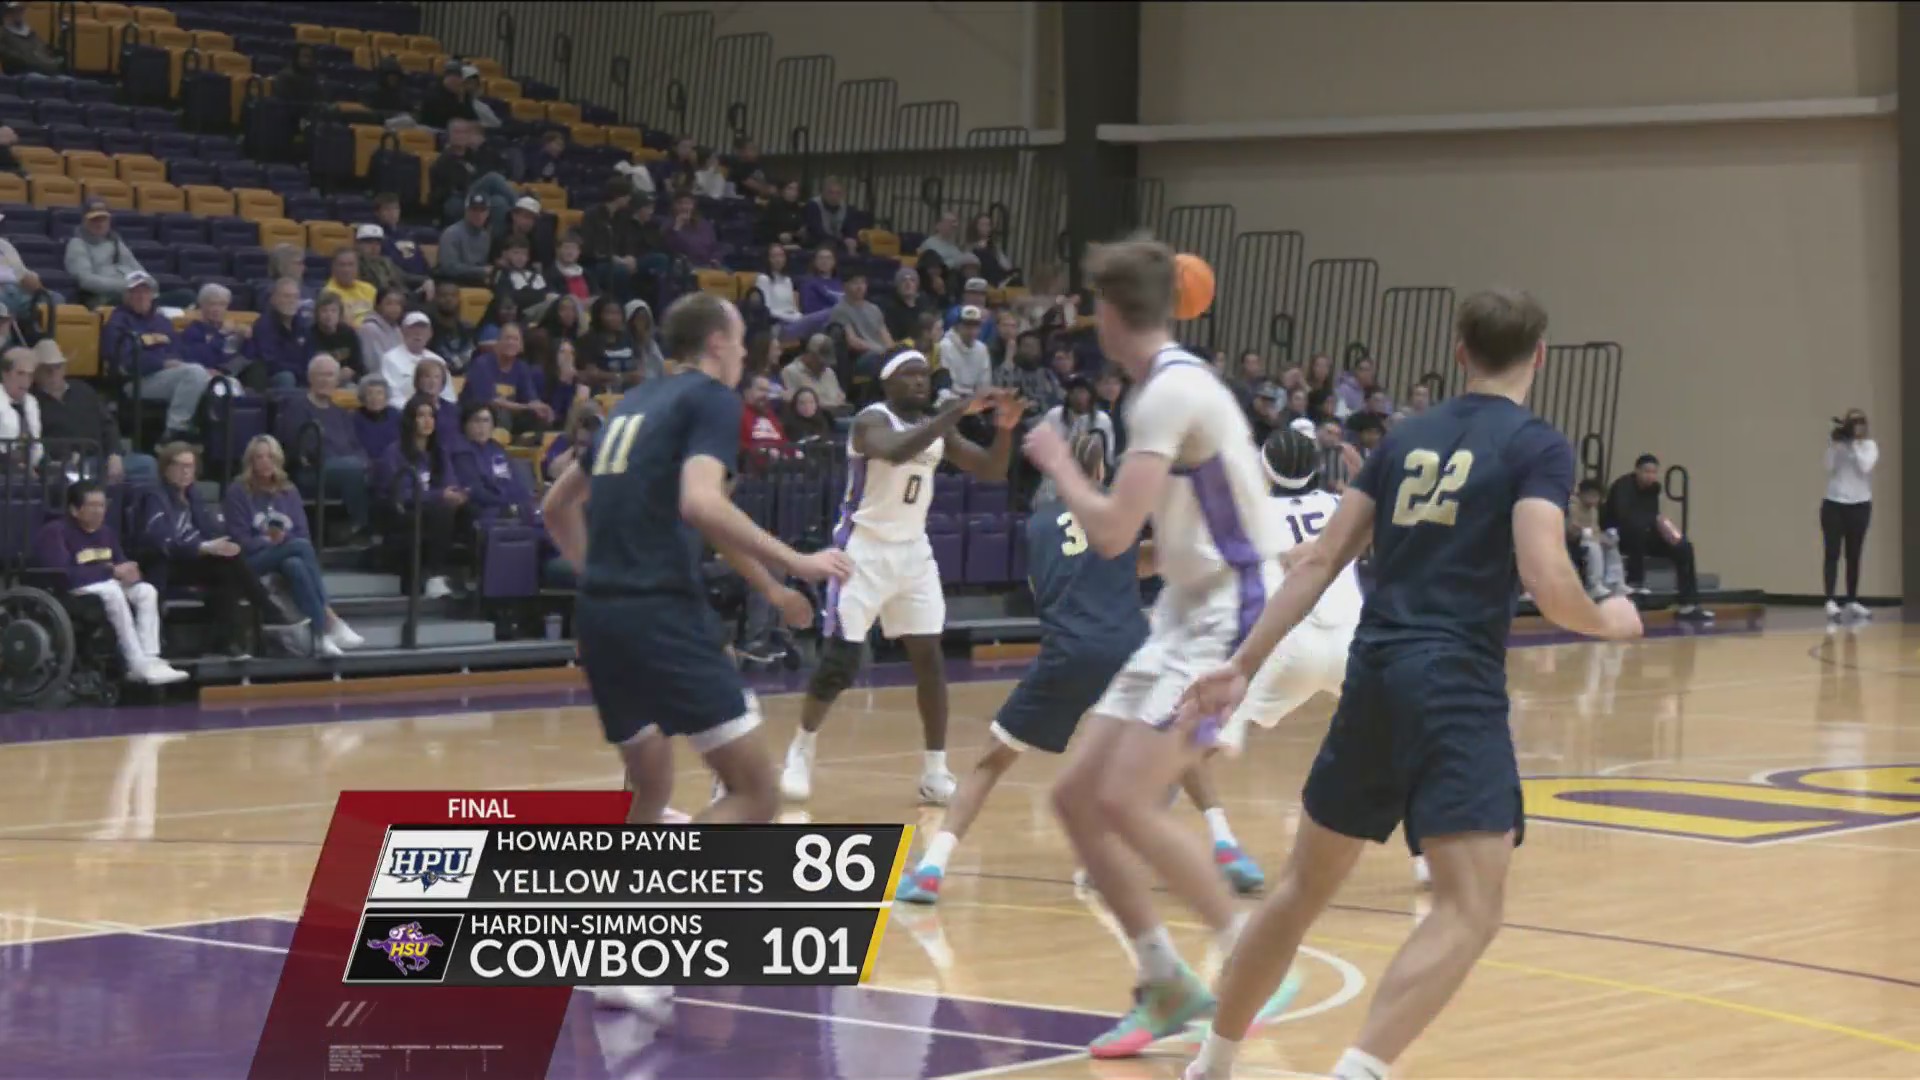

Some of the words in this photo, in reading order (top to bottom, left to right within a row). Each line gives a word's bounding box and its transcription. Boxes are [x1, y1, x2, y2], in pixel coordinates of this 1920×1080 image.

[592, 414, 645, 475] 11
[904, 475, 922, 504] 0
[1392, 449, 1474, 526] 22
